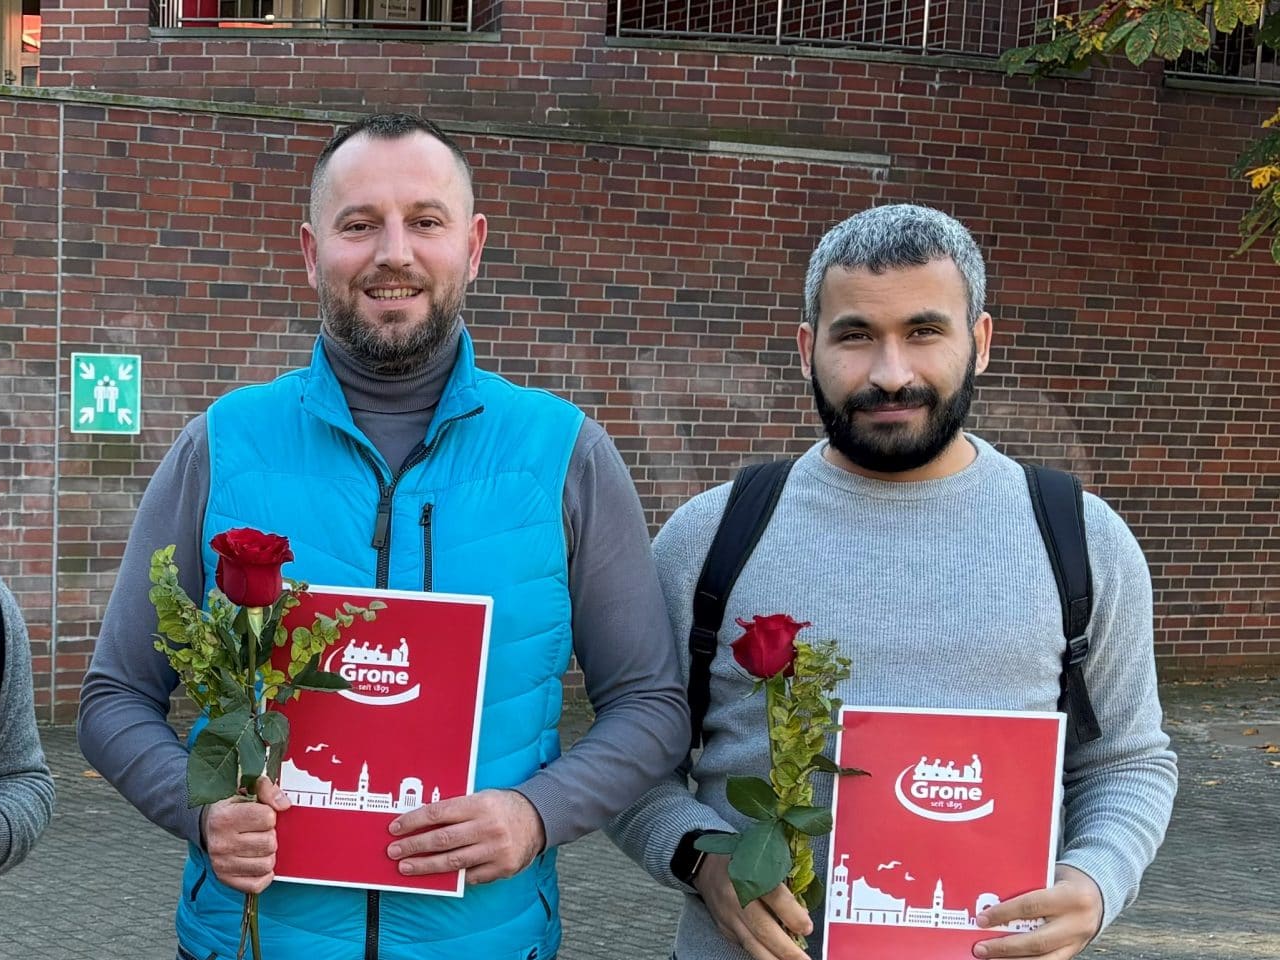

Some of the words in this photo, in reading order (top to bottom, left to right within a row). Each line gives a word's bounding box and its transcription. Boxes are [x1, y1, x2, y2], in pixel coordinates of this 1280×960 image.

[340, 664, 410, 685] Grone
[373, 684, 390, 694] 1895
[910, 781, 983, 801] Grone
